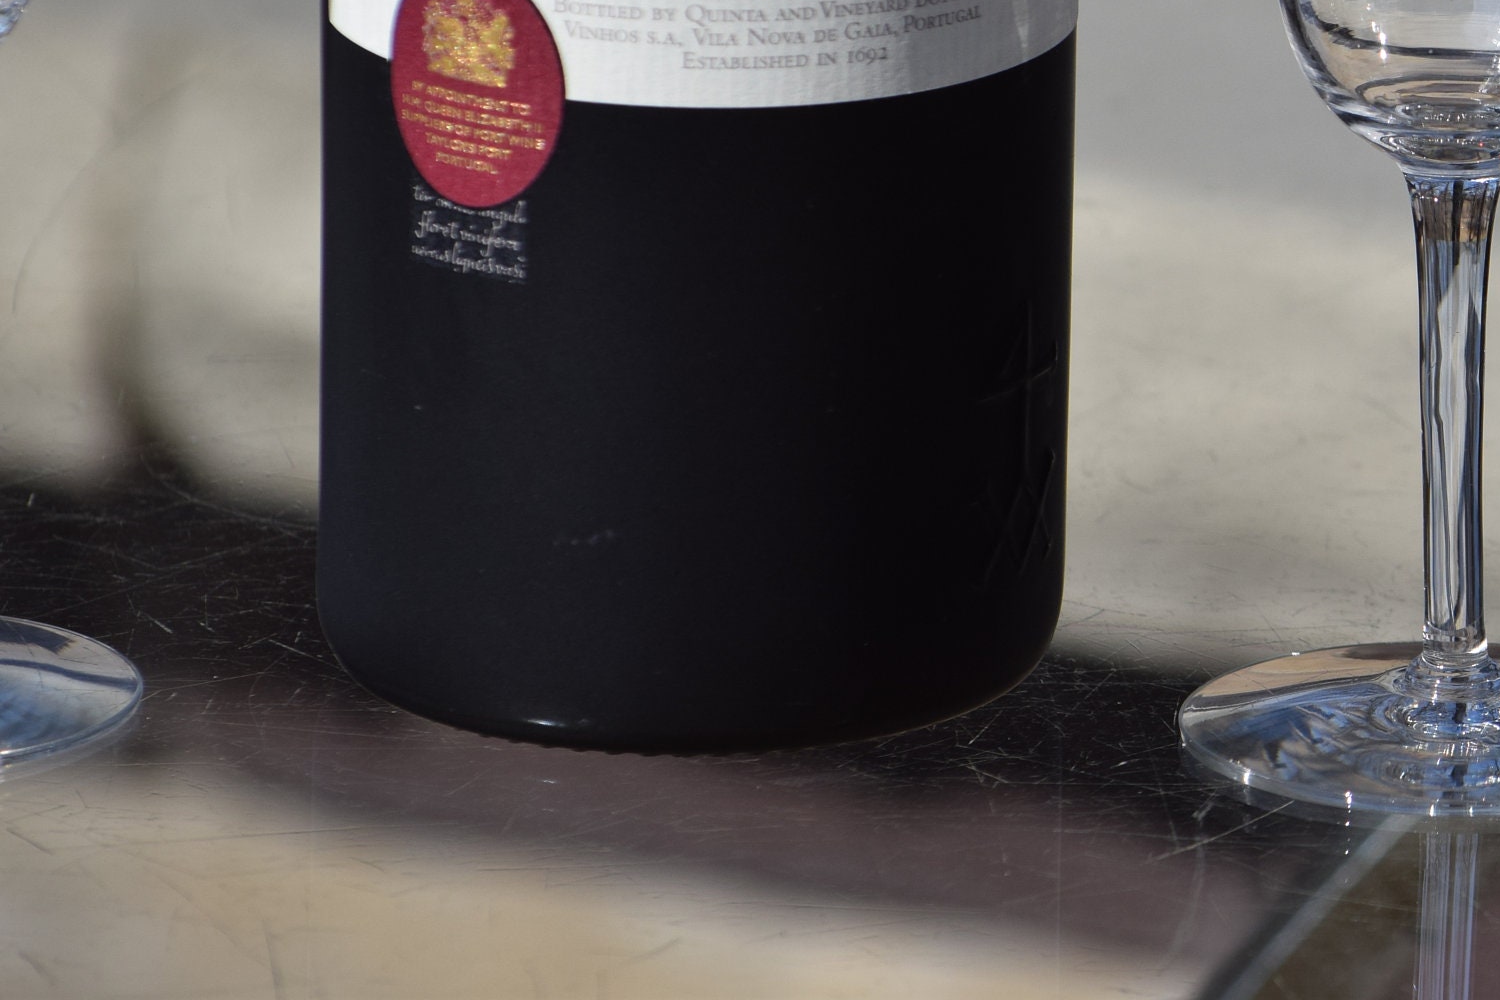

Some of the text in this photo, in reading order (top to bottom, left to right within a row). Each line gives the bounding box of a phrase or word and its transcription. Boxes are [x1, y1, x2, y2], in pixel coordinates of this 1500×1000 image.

[651, 7, 678, 21] BY
[684, 3, 768, 27] QUINTA
[774, 6, 817, 21] AND
[691, 28, 739, 47] VILA
[746, 28, 806, 47] NOVA
[812, 29, 839, 43] DE
[902, 5, 983, 34] PORTUGAL
[680, 46, 890, 71] ESTABLISHED IN 1692
